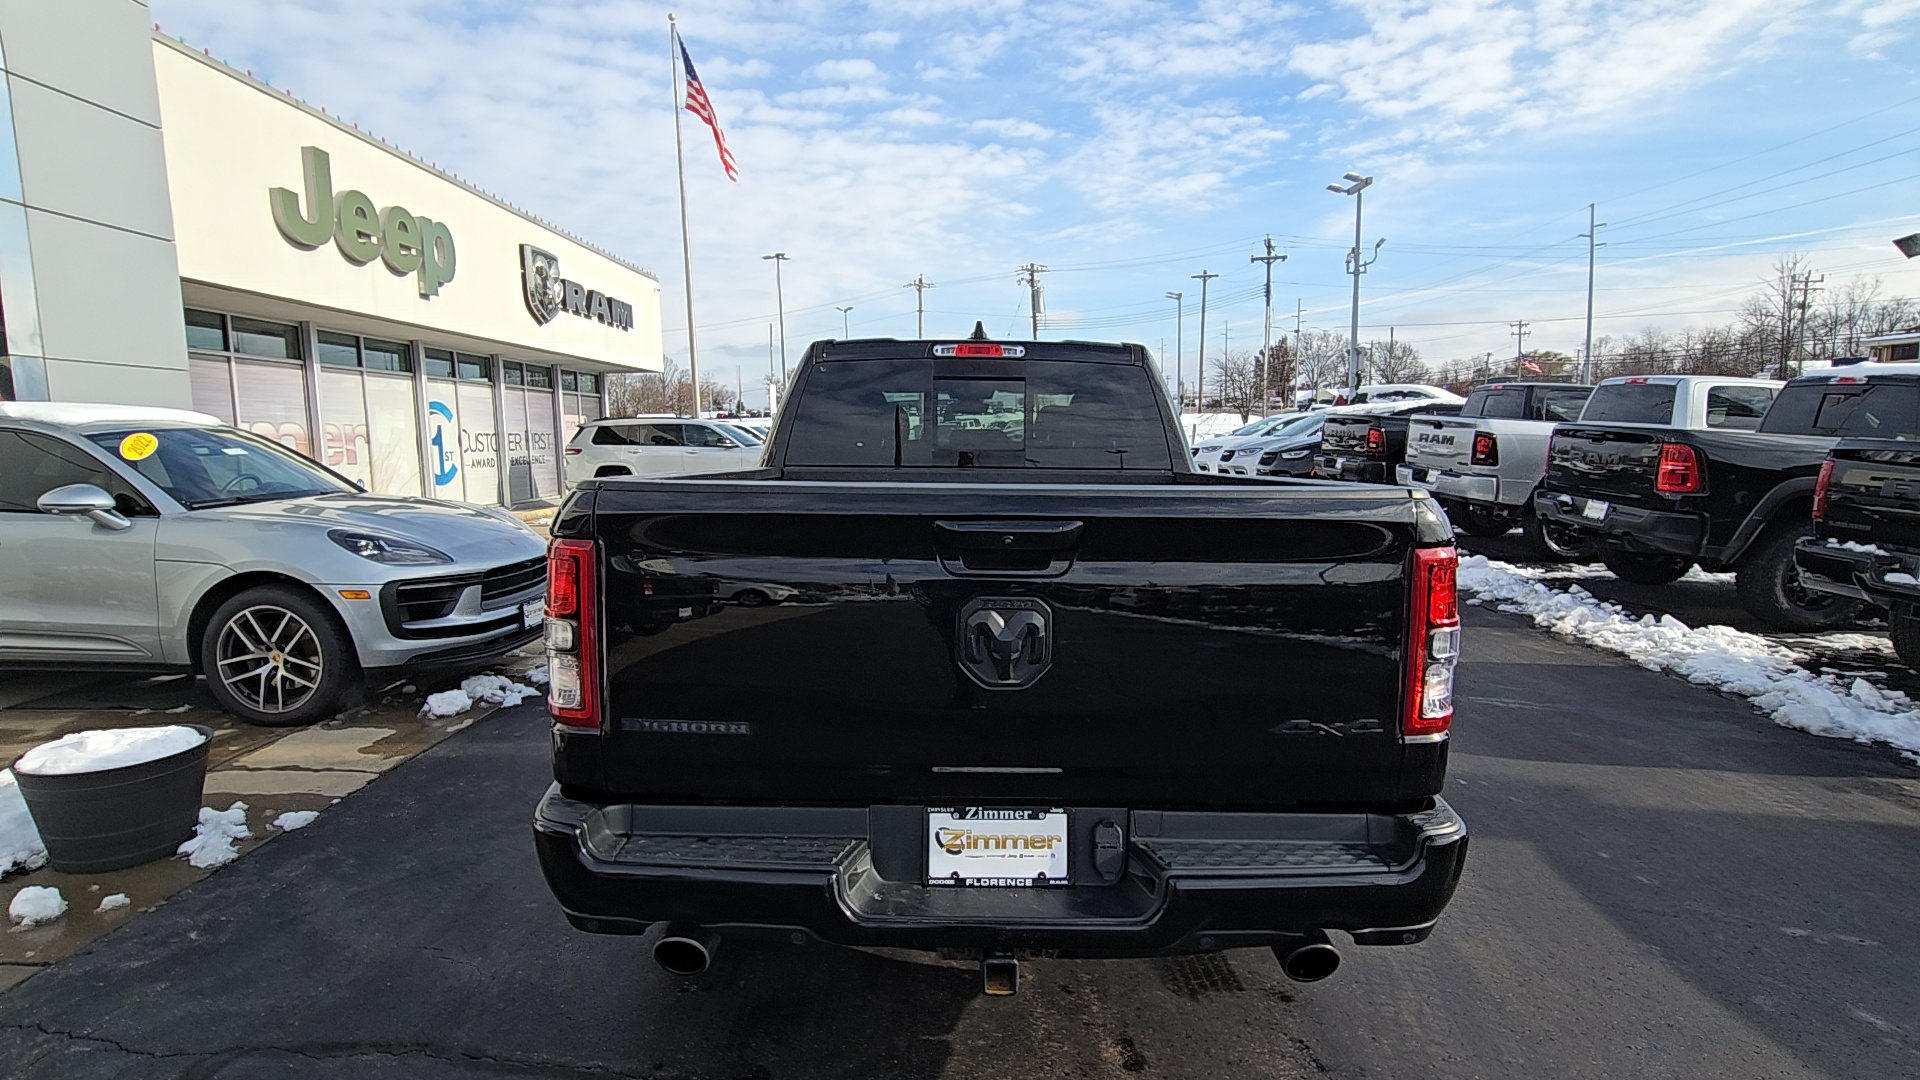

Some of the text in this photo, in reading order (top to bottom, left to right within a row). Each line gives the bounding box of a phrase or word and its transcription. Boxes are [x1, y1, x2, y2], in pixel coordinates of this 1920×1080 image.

[268, 146, 456, 301] Jeep
[560, 278, 634, 332] RAM
[127, 435, 152, 456] 2022
[462, 429, 522, 453] CUSTOER
[1418, 432, 1456, 446] RAM
[471, 455, 546, 469] AWARD EXCELENCE
[1568, 448, 1621, 465] RAM
[965, 806, 1032, 820] Zimmer
[943, 829, 1063, 850] Zimmer
[965, 878, 1033, 886] FLORENCE
